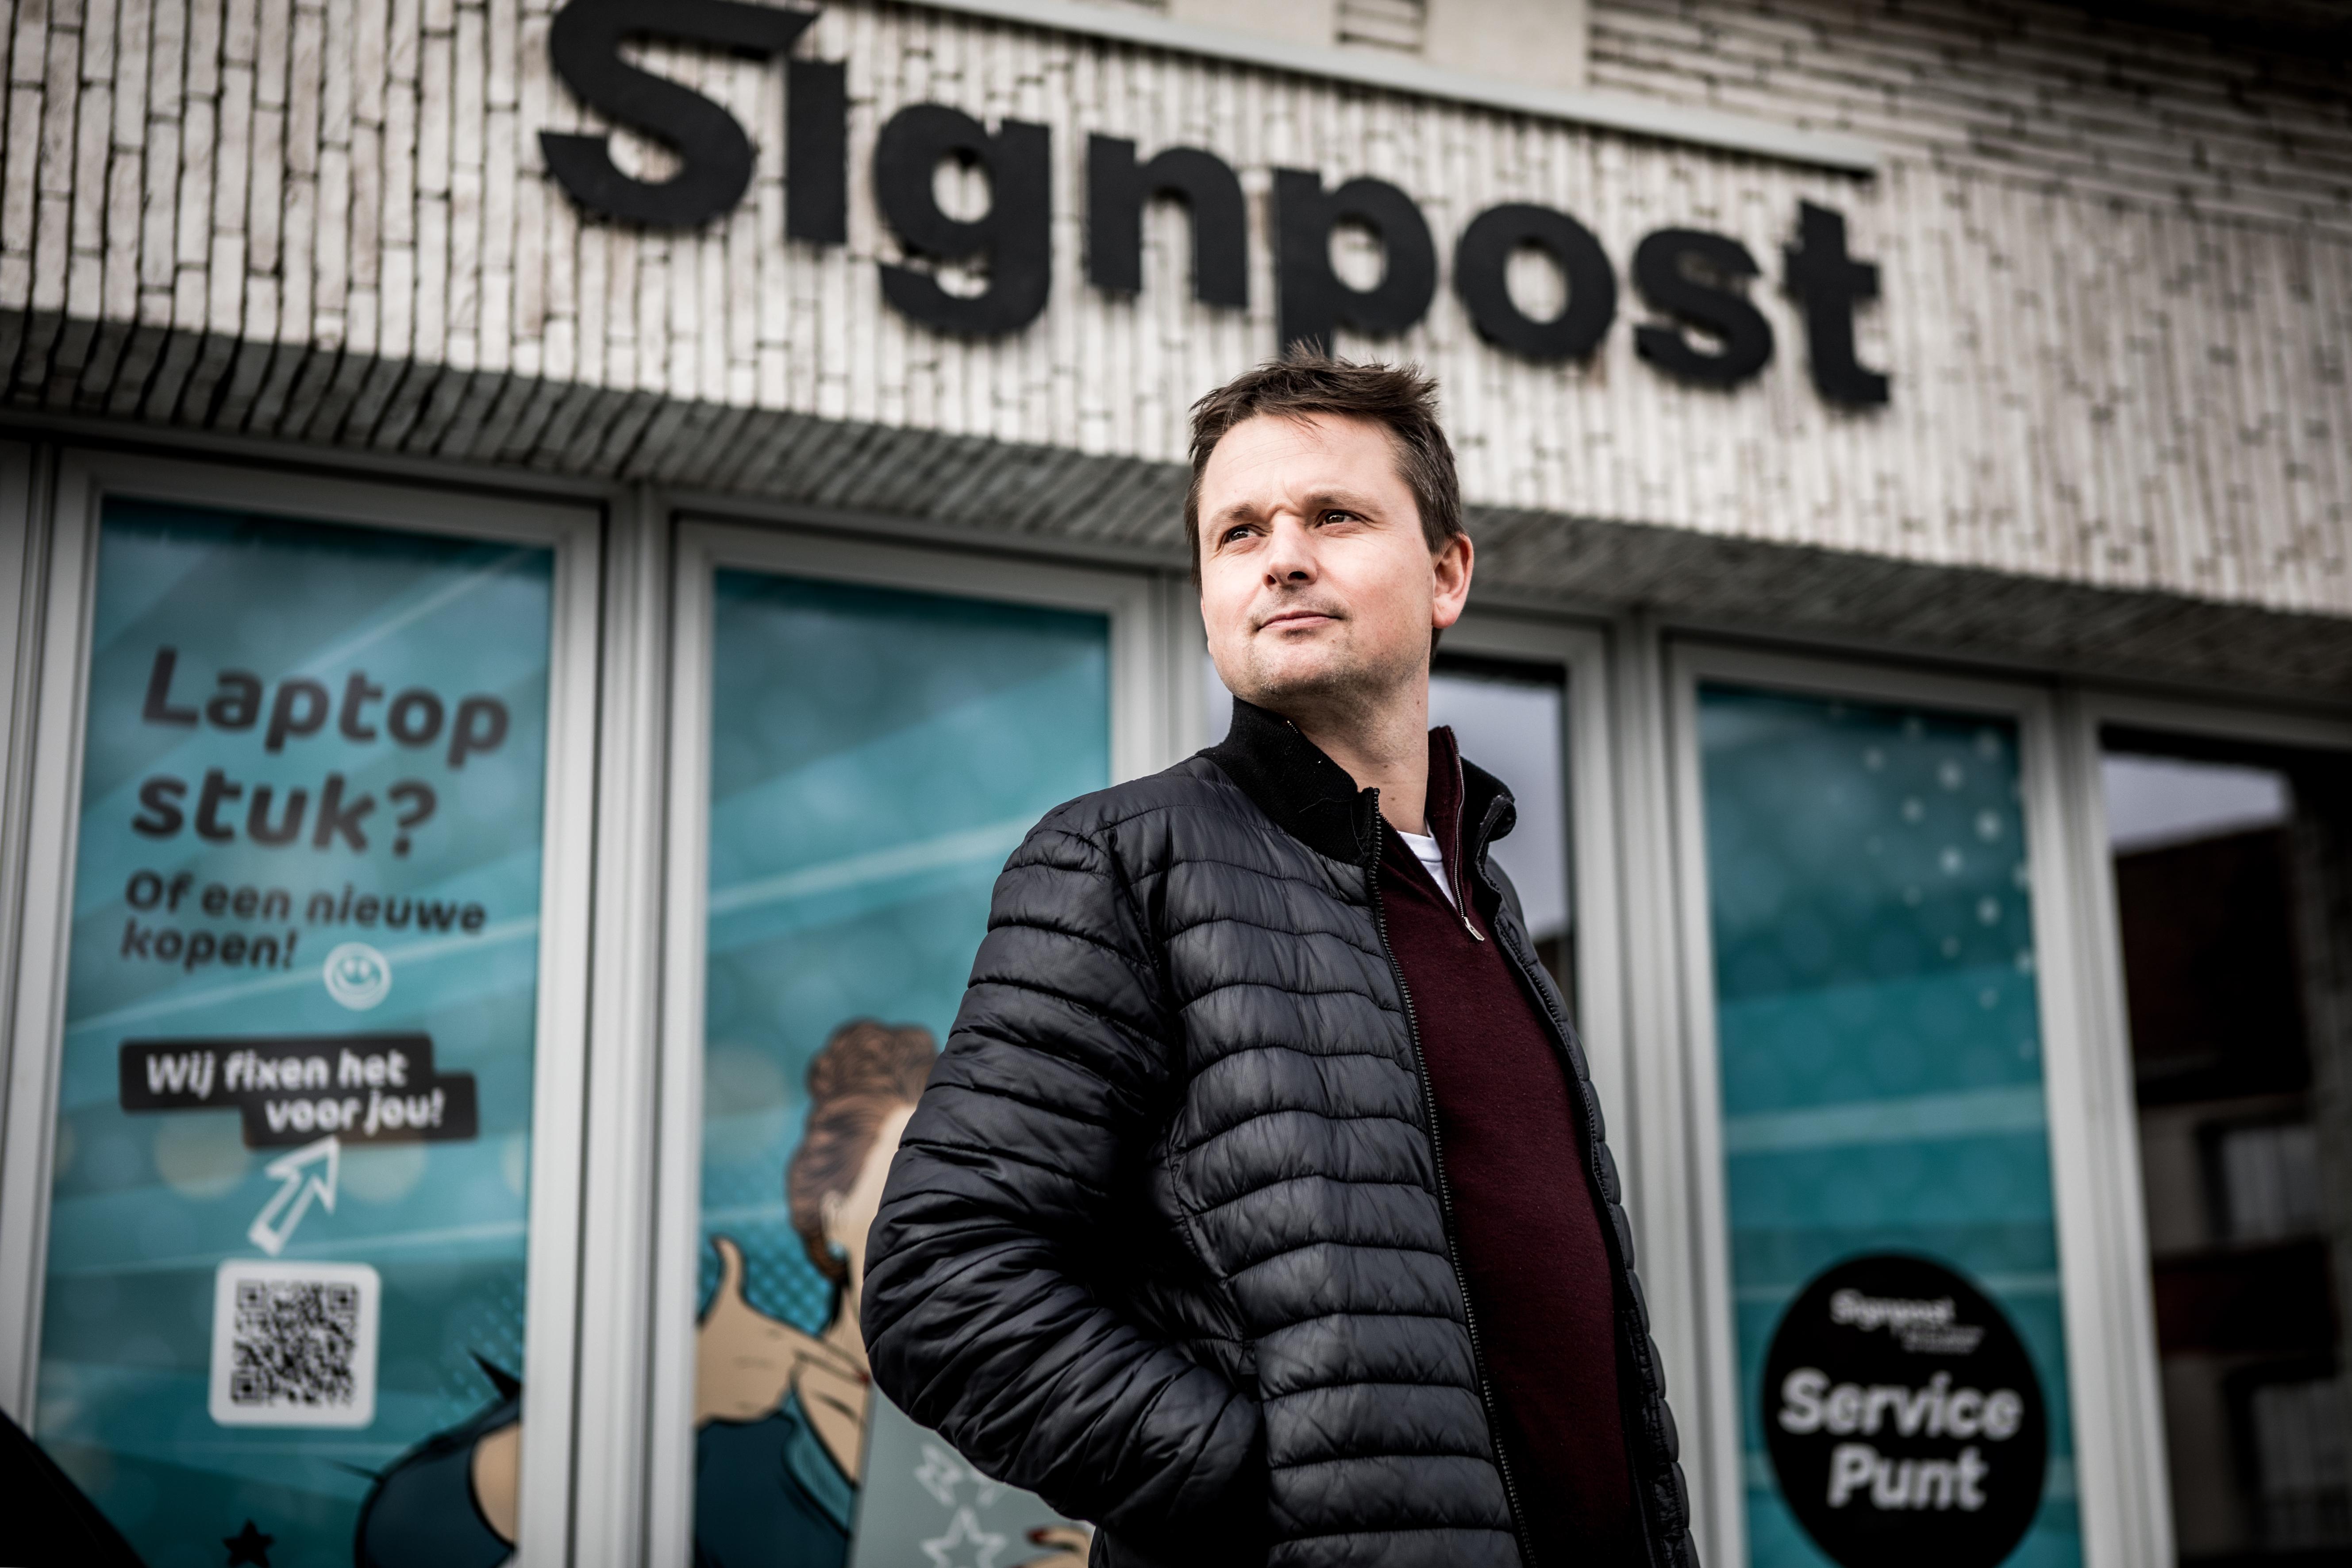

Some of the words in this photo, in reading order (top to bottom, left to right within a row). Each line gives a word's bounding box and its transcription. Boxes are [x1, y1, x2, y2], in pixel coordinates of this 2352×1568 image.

[538, 0, 1889, 406] Signpost
[144, 647, 508, 768] Laptop
[132, 768, 436, 857] stuk?
[125, 870, 193, 913] Of
[201, 884, 289, 921] een
[306, 882, 487, 935] nieuwe
[121, 916, 296, 971] kopen!
[146, 1053, 215, 1098] Wij
[225, 1050, 329, 1090] fixen
[339, 1049, 407, 1086] het
[266, 1098, 356, 1132] voor
[363, 1089, 444, 1134] jou!
[1779, 1368, 2023, 1441] Service
[1828, 1443, 1988, 1511] Punt
